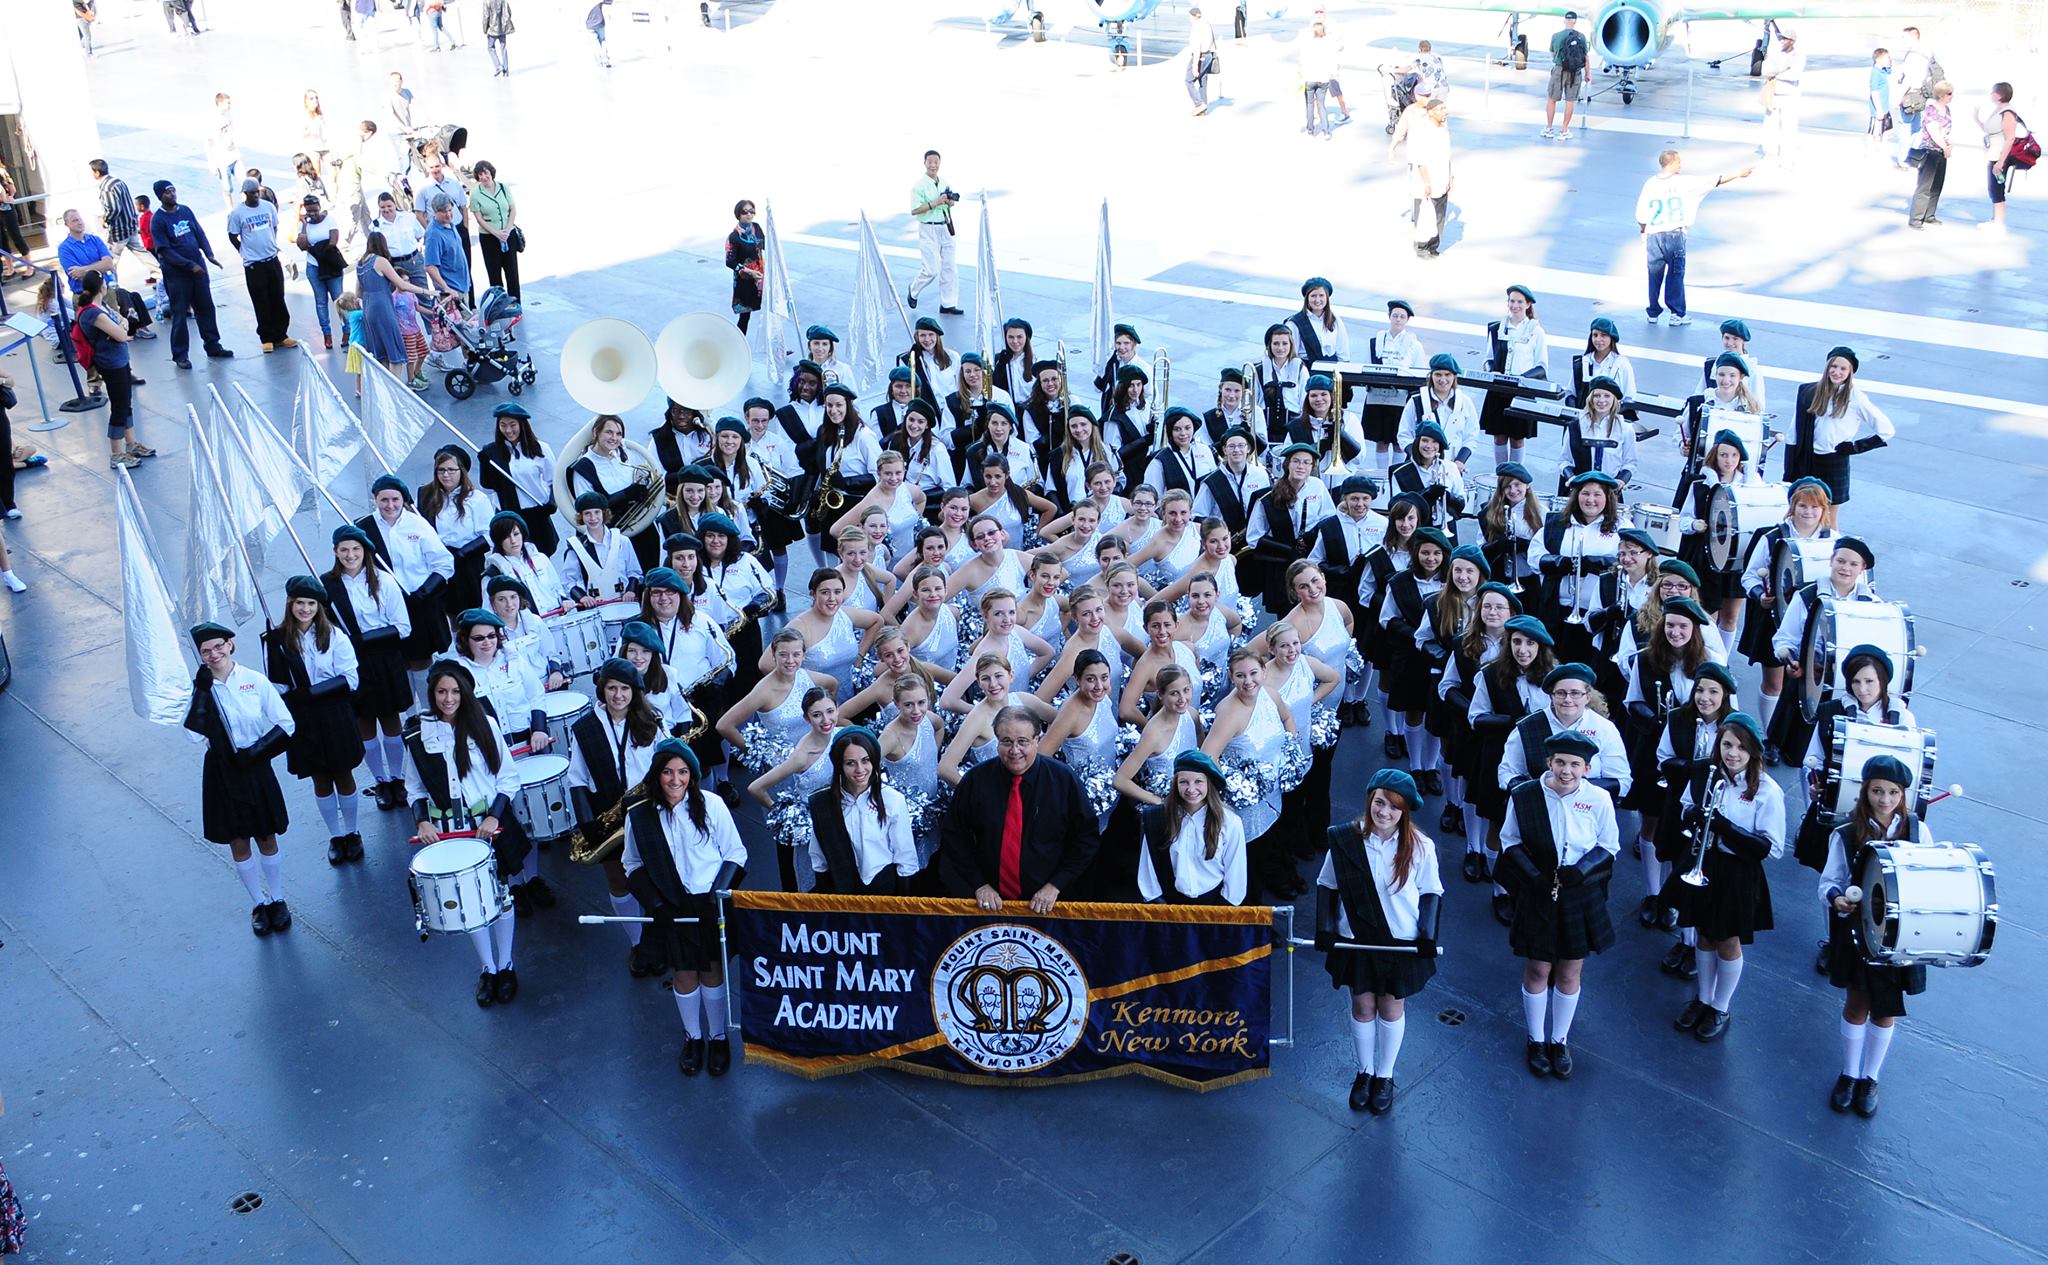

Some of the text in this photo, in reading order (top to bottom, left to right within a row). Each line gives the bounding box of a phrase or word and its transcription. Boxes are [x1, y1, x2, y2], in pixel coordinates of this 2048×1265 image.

[1649, 196, 1684, 226] 28
[1573, 802, 1592, 811] MSM
[780, 922, 882, 956] MOUNT
[940, 929, 1078, 978] MOUNT SAINT MARY
[753, 956, 916, 992] SAINT MARY
[773, 994, 899, 1031] ACADEMY
[1111, 1001, 1246, 1028] Kenmore,
[952, 1037, 1044, 1068] KENMORE,
[1097, 1027, 1257, 1059] New York
